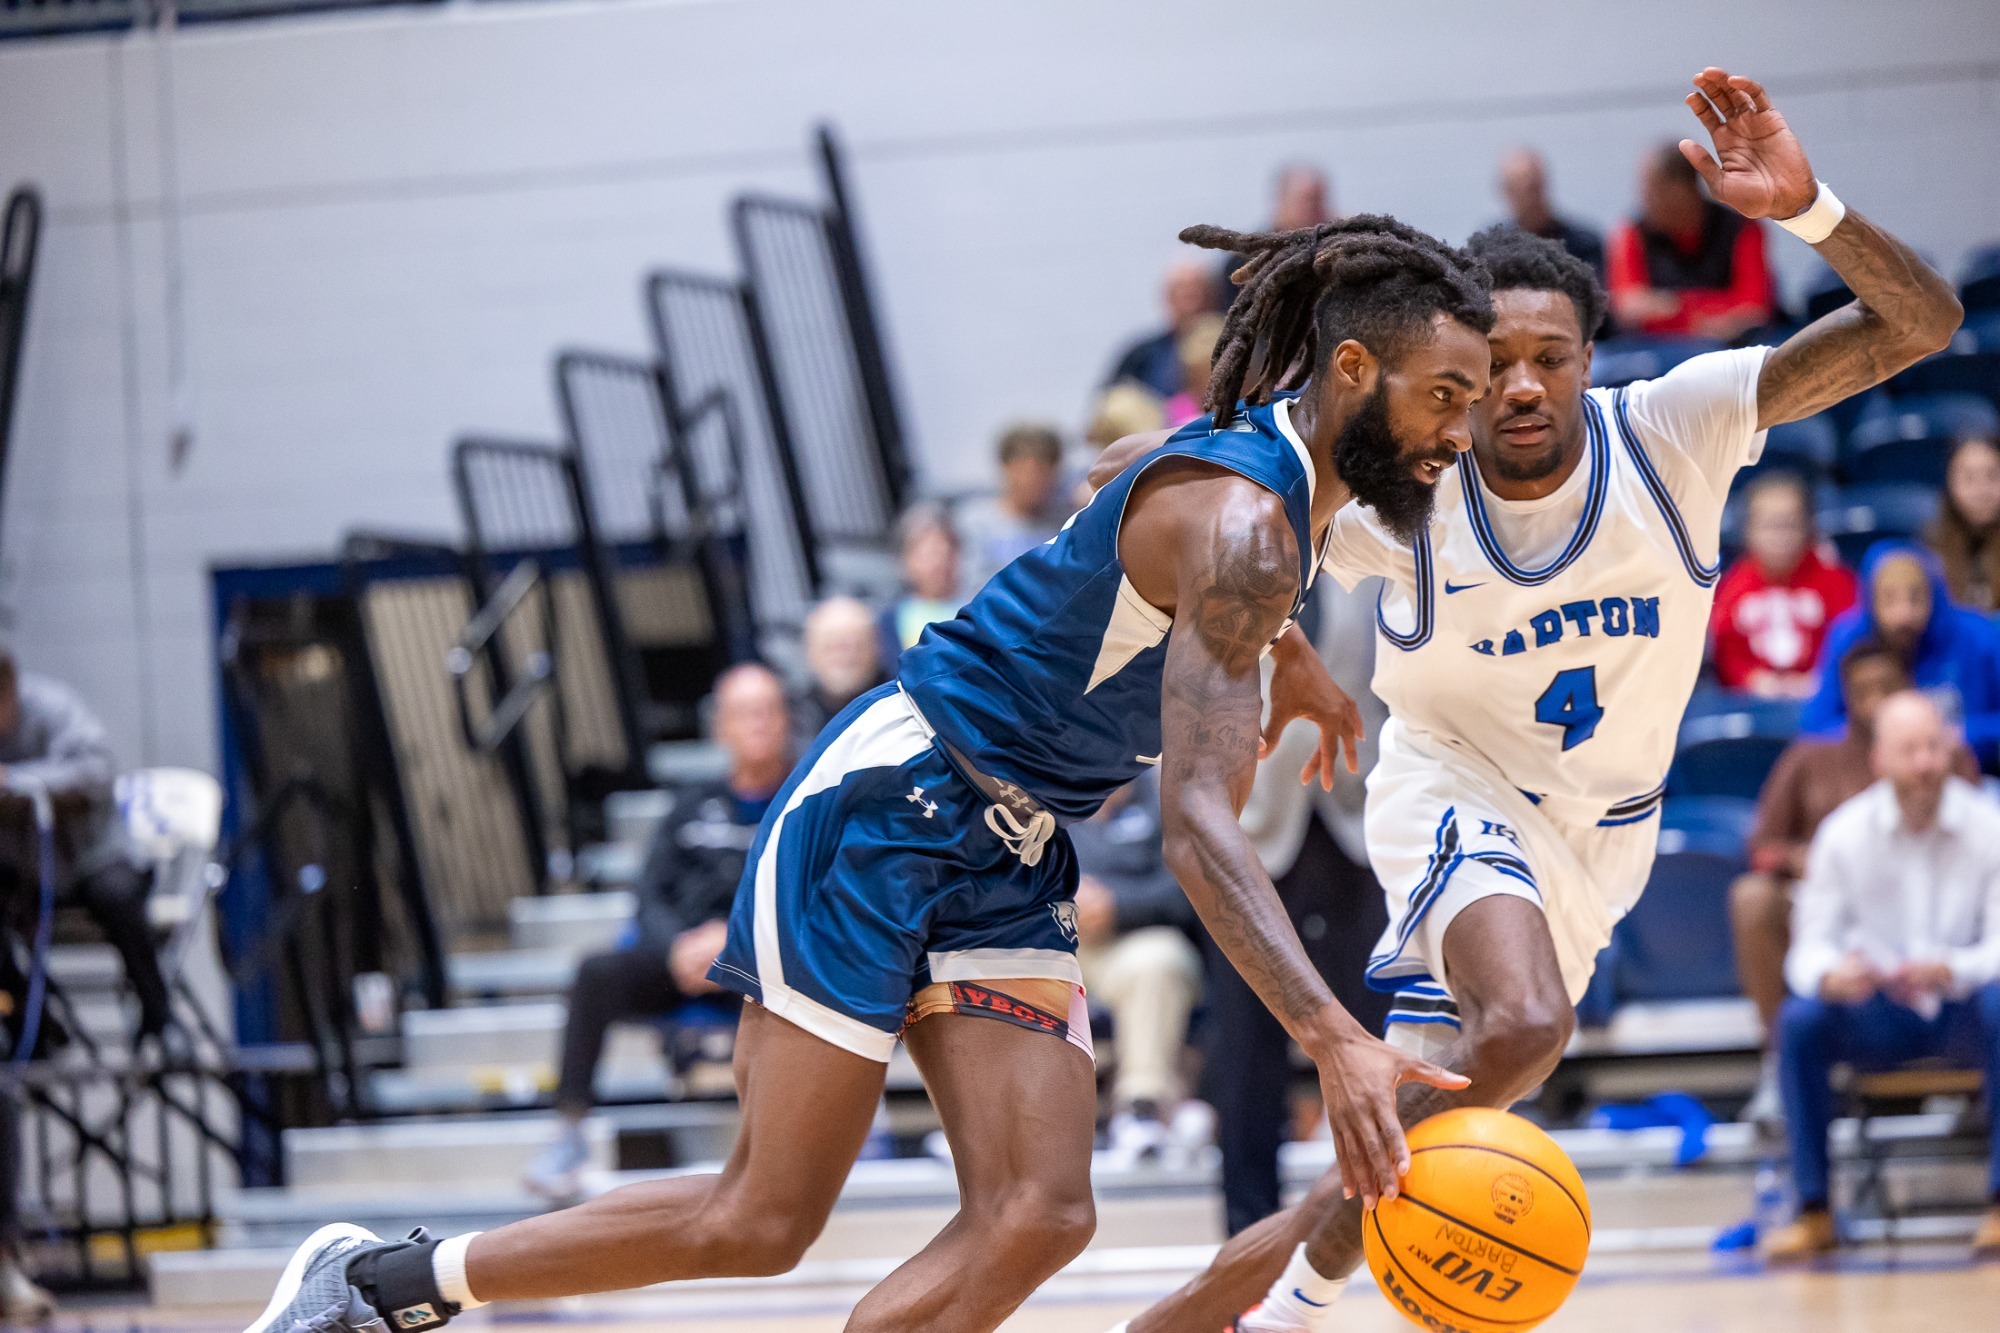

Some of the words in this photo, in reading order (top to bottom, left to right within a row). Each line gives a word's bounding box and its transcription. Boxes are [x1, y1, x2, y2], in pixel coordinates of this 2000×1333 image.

[1535, 665, 1604, 752] 4
[1406, 1244, 1433, 1264] NXT
[1435, 1222, 1518, 1274] BARTON
[1431, 1250, 1523, 1303] EVO
